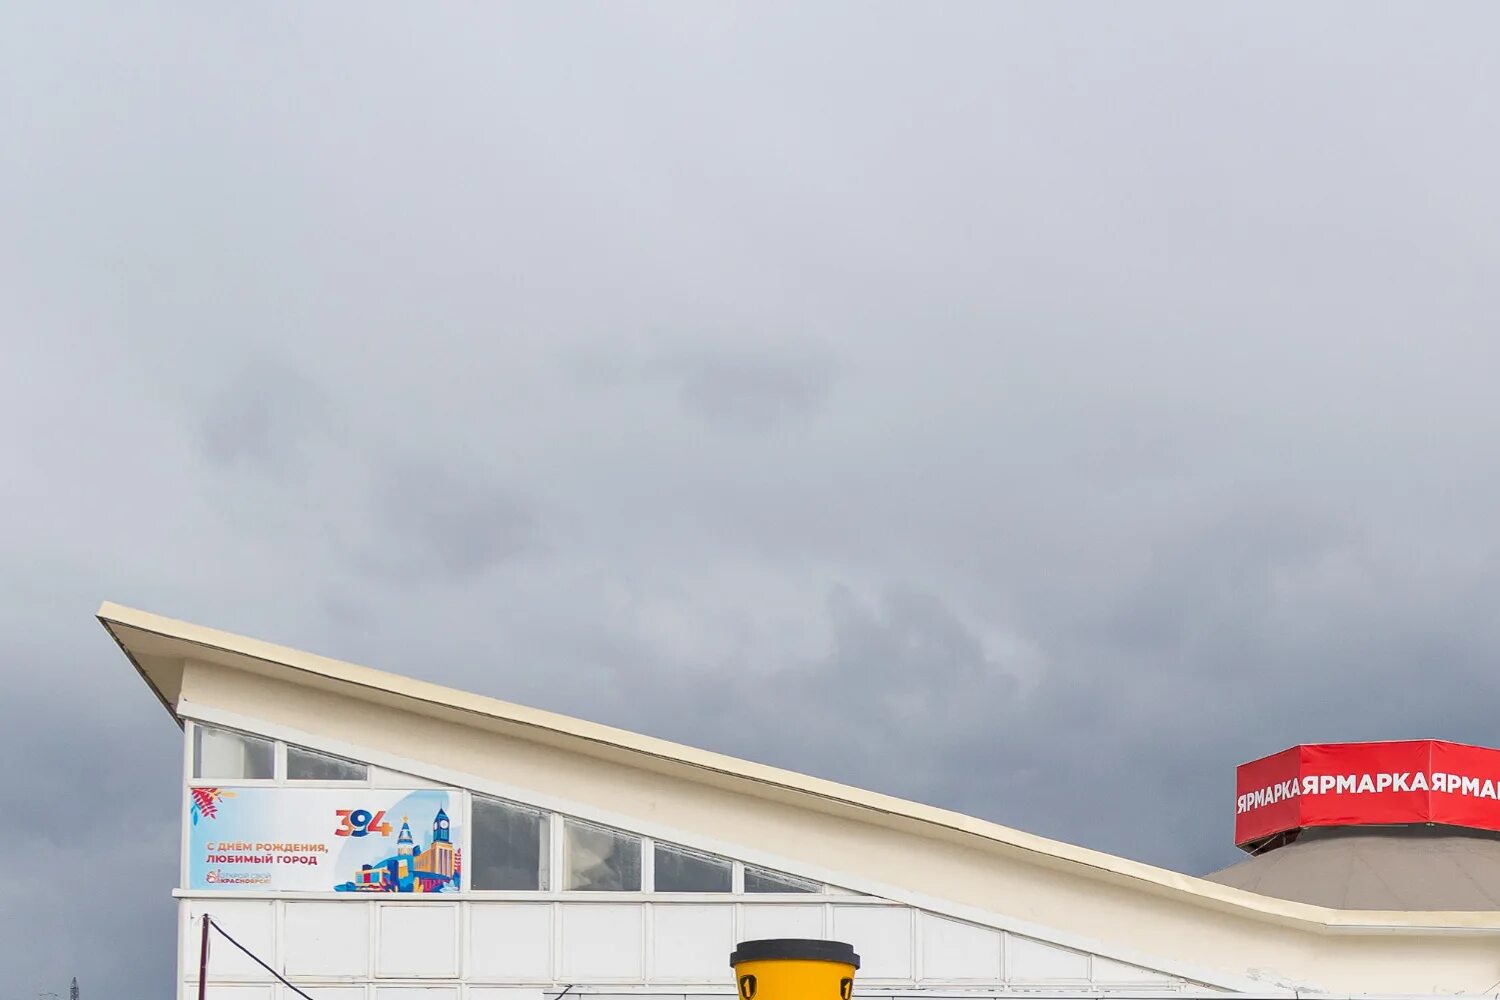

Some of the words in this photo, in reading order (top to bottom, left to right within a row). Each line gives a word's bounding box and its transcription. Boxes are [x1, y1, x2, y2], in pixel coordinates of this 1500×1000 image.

[1237, 776, 1300, 814] ЯРМАРКА
[1301, 772, 1429, 795] ЯРМАРКА
[334, 809, 393, 838] 394
[206, 853, 273, 864] ЛЮБИМЫЙ
[277, 856, 318, 865] ГОРОД
[207, 843, 214, 851] С
[256, 843, 328, 854] РОЖДЕНИЯ,
